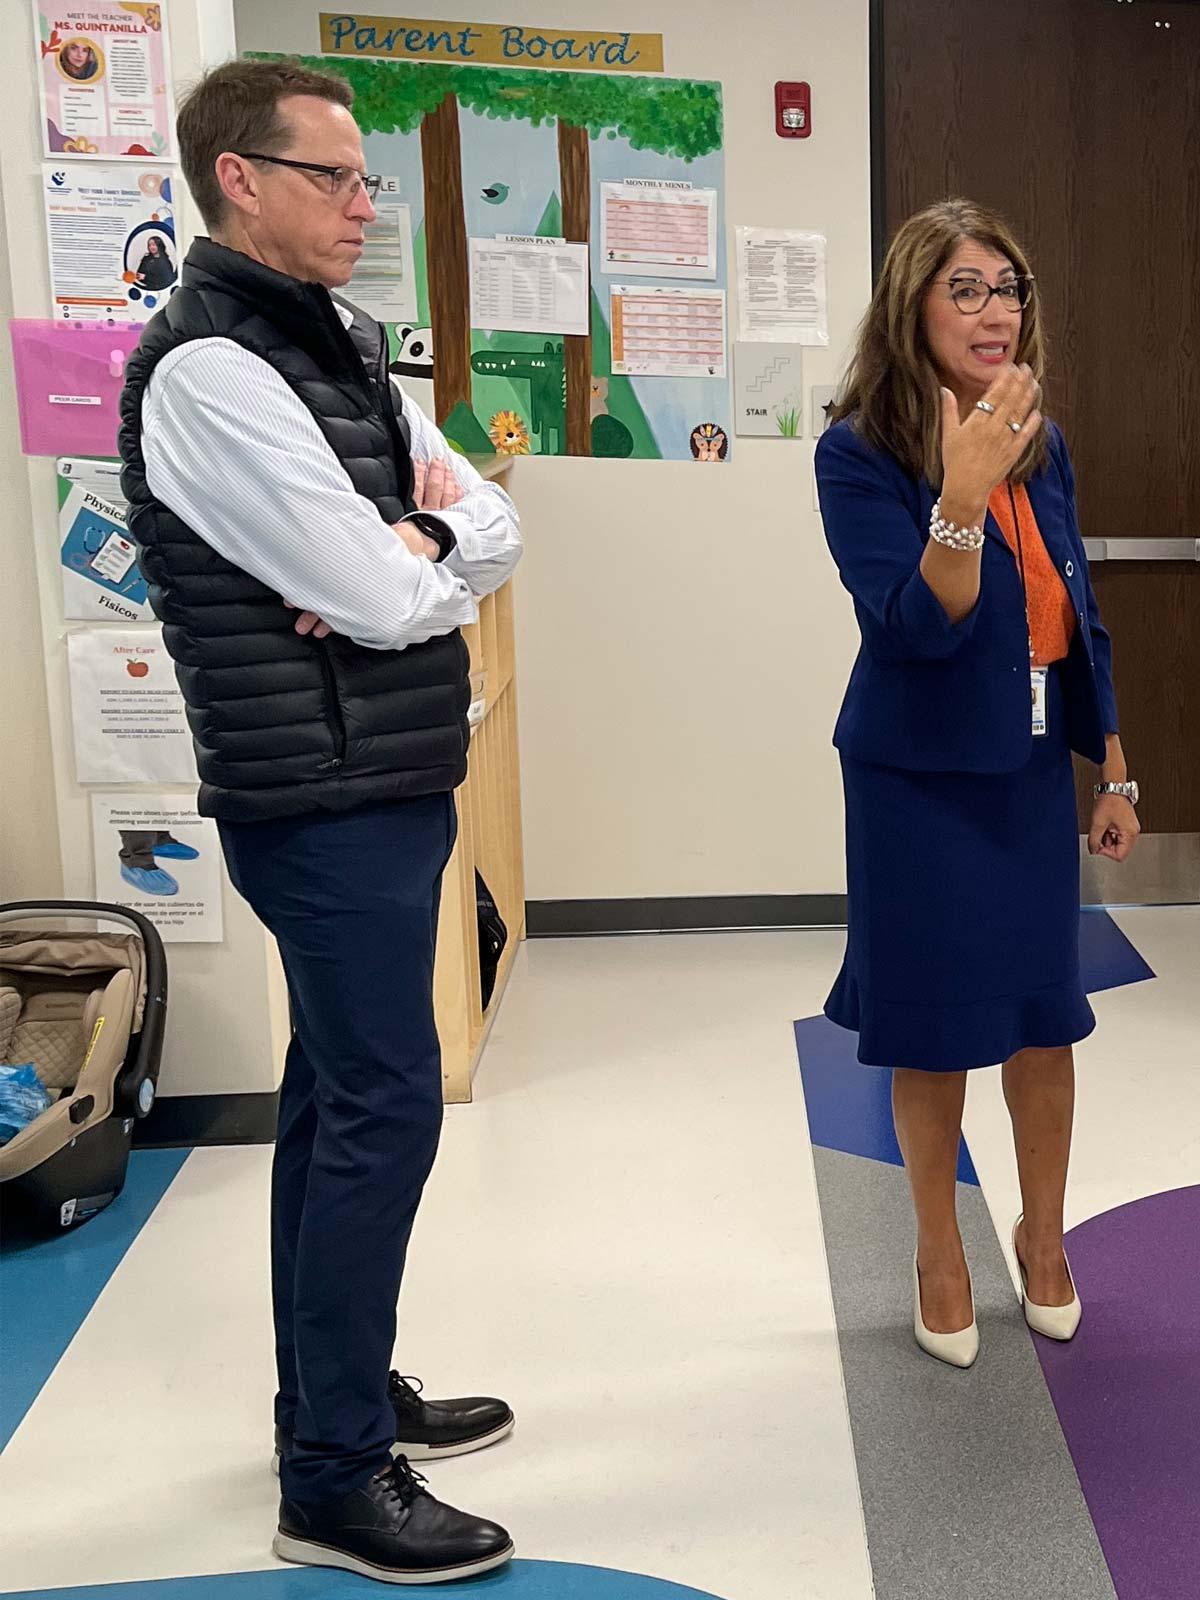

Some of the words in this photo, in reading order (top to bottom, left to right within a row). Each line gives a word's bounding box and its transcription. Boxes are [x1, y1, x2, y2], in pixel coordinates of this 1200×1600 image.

[55, 21, 73, 30] MS.
[75, 23, 147, 33] QUINTANILLA
[329, 16, 482, 56] Parent
[501, 26, 640, 65] Board
[625, 179, 662, 188] MONTHLY
[664, 181, 691, 190] MENUS
[505, 236, 534, 244] LESSON
[535, 237, 556, 245] PLAN
[746, 408, 768, 416] STAIR
[83, 493, 126, 522] Physica
